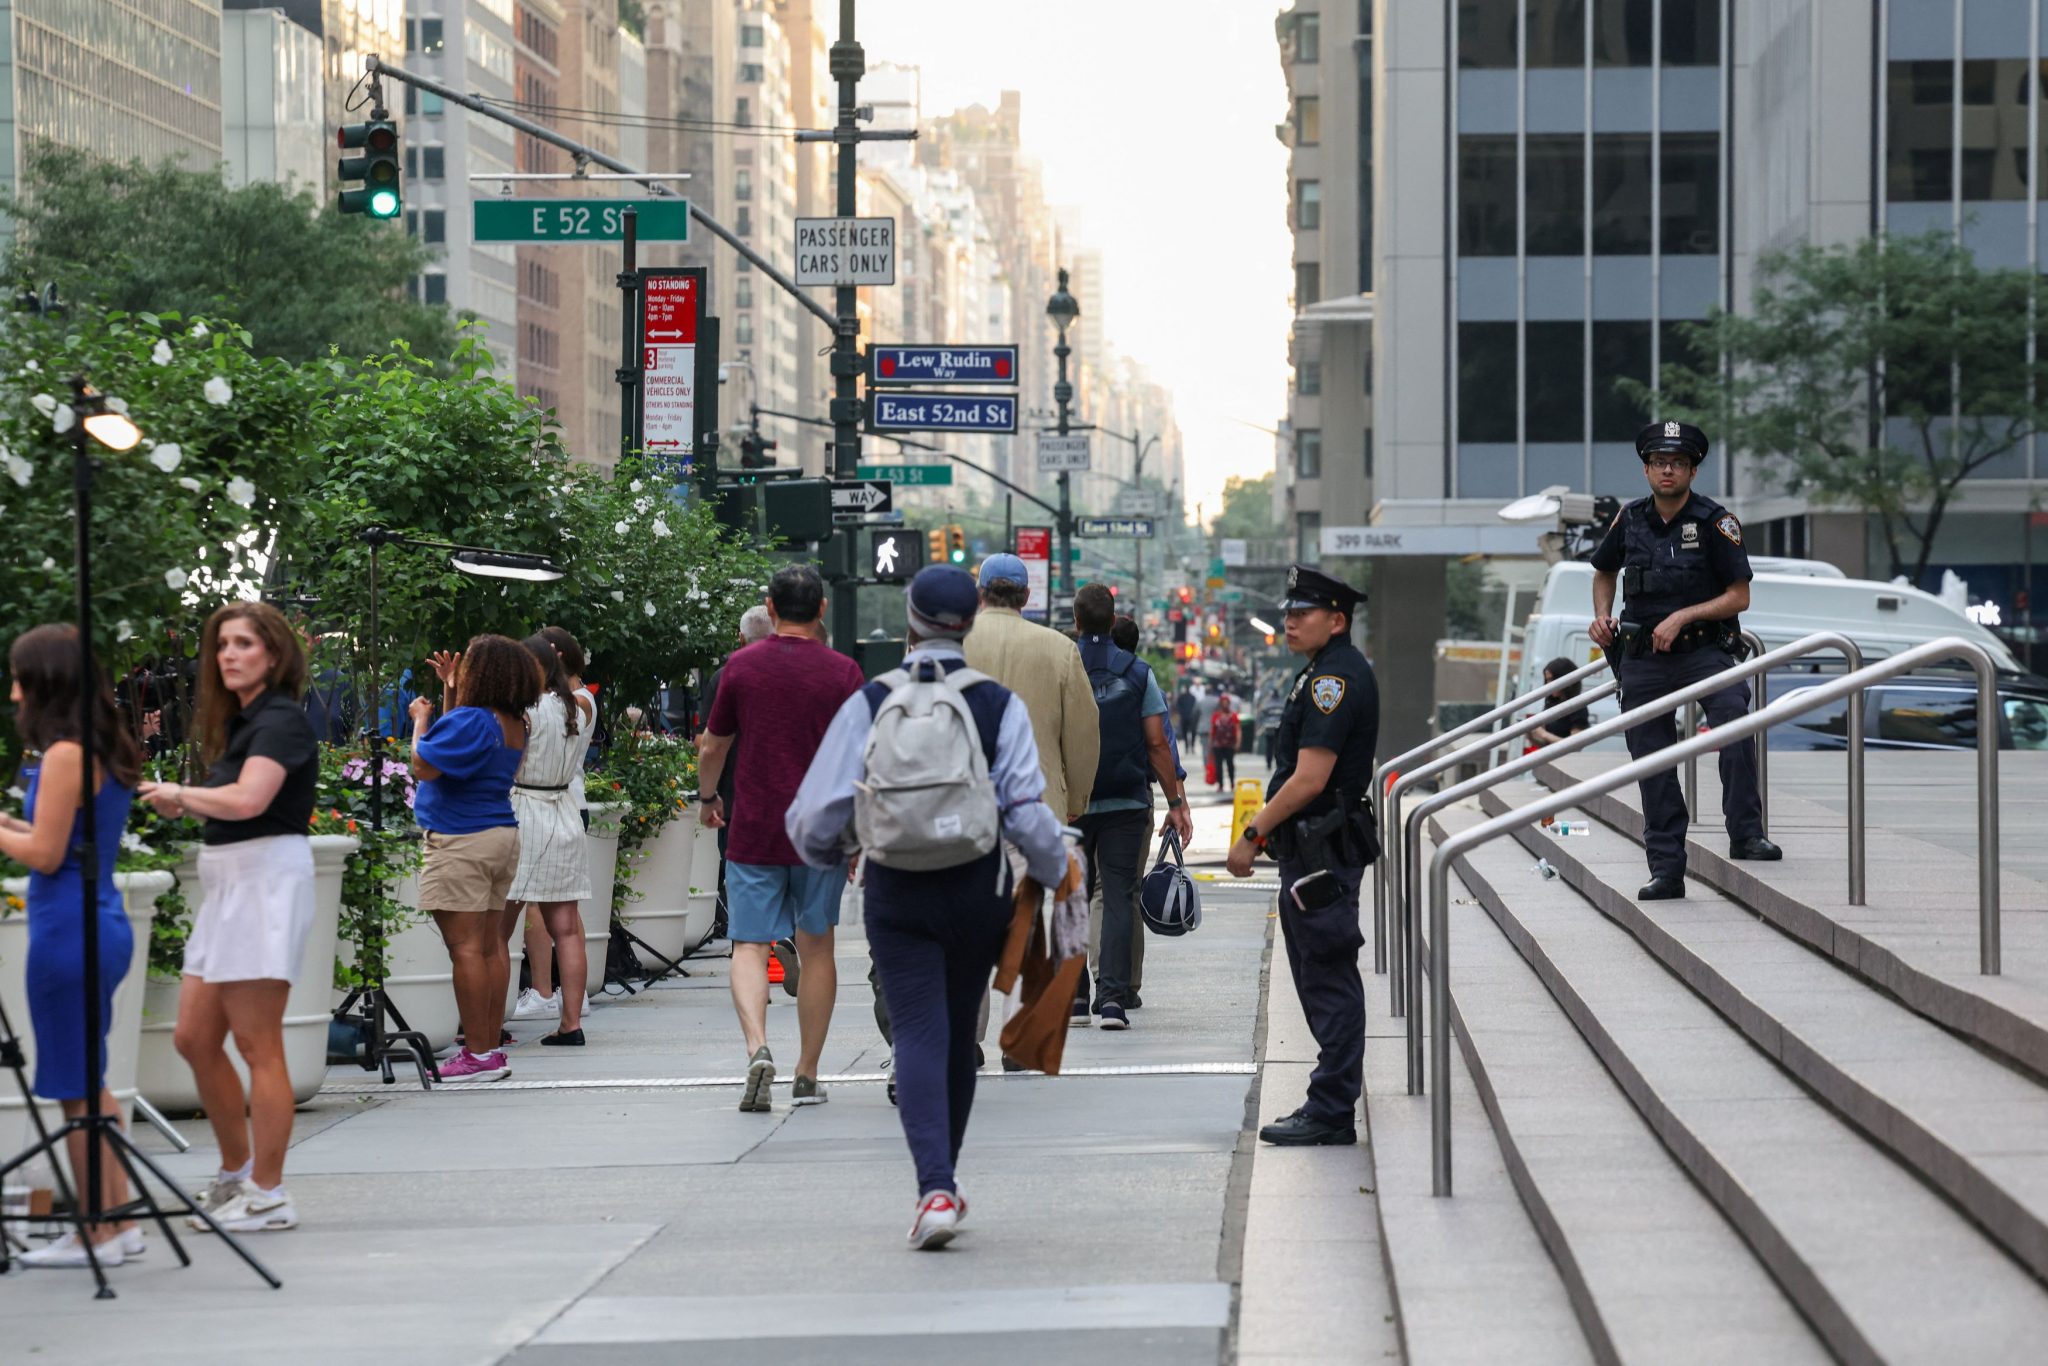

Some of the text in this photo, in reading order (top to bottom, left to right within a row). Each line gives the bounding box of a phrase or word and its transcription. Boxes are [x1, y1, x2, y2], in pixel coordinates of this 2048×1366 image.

[533, 208, 547, 234] E
[559, 207, 591, 234] 52
[800, 228, 889, 247] PASSENGER
[800, 254, 888, 273] CARS ONLY
[648, 280, 690, 290] NO STANDING
[648, 295, 666, 303] Monday
[670, 295, 685, 304] Friday
[648, 304, 658, 312] 7am
[662, 304, 675, 312] 10am
[648, 313, 658, 322] 4pm
[662, 313, 673, 322] 7pm
[646, 349, 655, 369] 3
[898, 351, 992, 368] Lew Rudin
[933, 367, 957, 380] Way
[646, 376, 685, 385] COMMERCIAL
[646, 387, 691, 396] VEHICLES ONLY
[646, 414, 663, 422] Monday
[668, 414, 682, 422] Friday
[881, 402, 1008, 425] East 52nd St
[888, 468, 905, 483] 53
[910, 468, 923, 483] St
[849, 492, 877, 503] WAY
[1364, 534, 1402, 549] PARK
